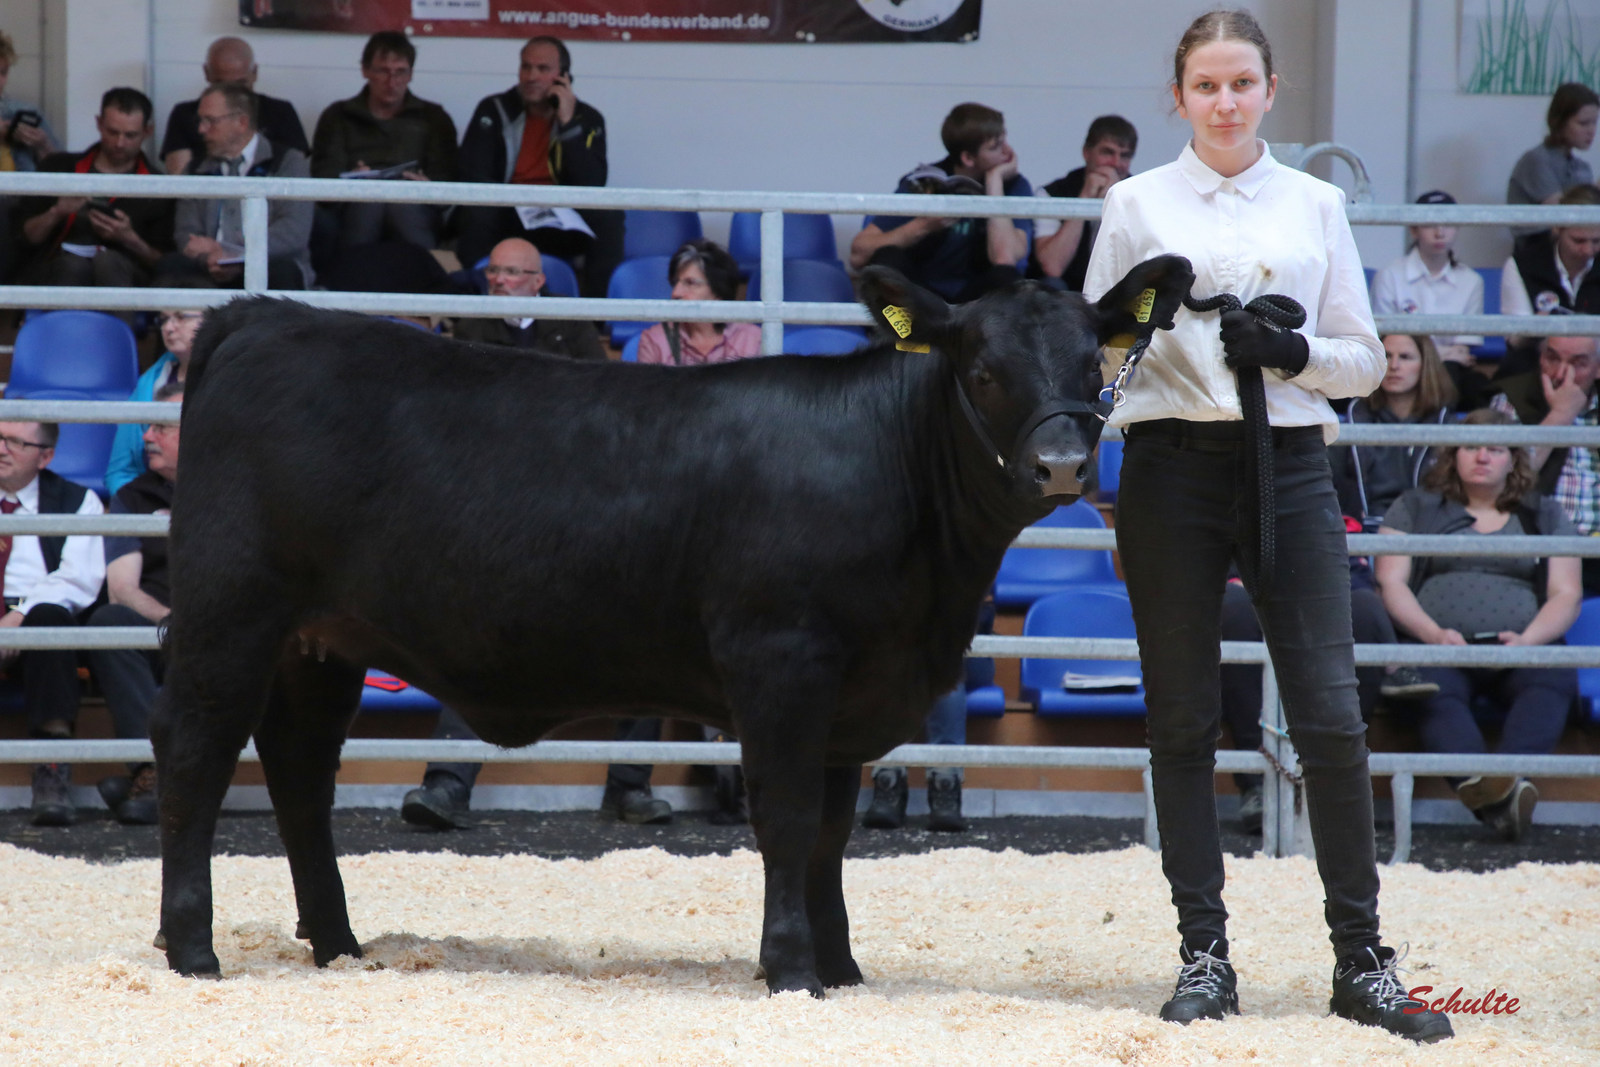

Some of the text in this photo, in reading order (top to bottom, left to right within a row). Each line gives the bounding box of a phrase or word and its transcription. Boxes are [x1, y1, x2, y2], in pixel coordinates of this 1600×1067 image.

[498, 10, 770, 29] www.angus-bundesverband.de
[882, 14, 940, 27] GERMANY
[1138, 290, 1155, 321] 81 652
[884, 306, 897, 319] 81
[893, 320, 910, 336] 652
